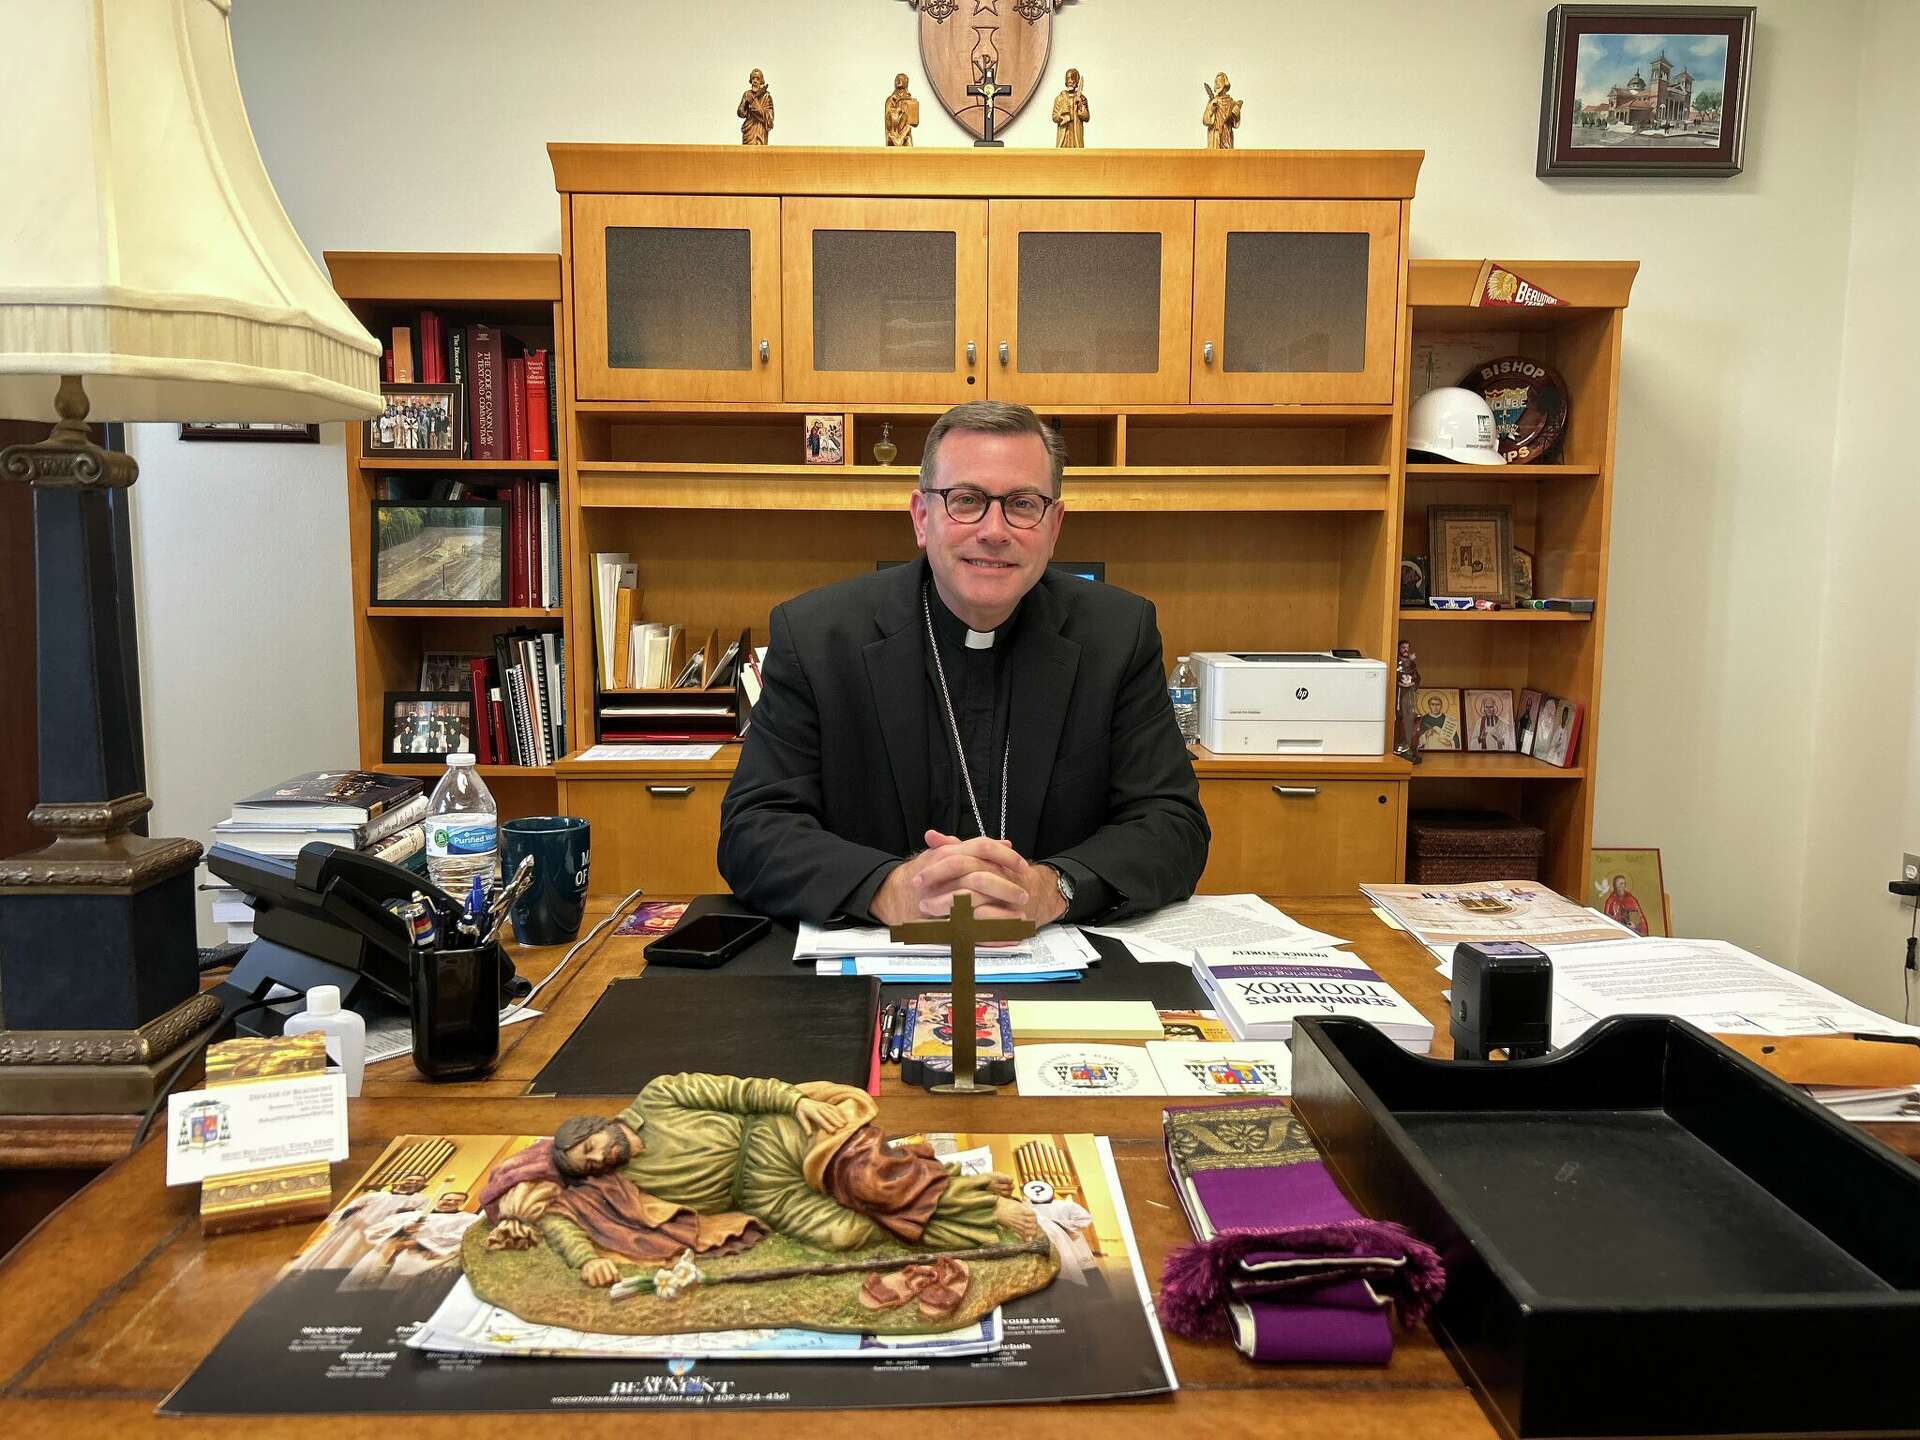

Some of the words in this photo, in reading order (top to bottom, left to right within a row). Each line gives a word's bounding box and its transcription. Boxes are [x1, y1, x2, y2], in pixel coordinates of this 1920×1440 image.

[1515, 281, 1558, 305] BEAUMONT
[1481, 360, 1546, 381] BISHOP
[484, 368, 492, 390] CODE
[478, 378, 486, 396] AND
[484, 390, 492, 401] OF
[479, 396, 487, 446] COMMENTARY
[485, 401, 493, 430] CANON
[1296, 687, 1309, 700] hp
[454, 836, 484, 844] Purified
[1282, 950, 1328, 958] PATRICK
[1274, 970, 1342, 978] Preparing
[1236, 982, 1388, 998] TOOLBOX
[1245, 996, 1398, 1008] SEMINARIAN'S
[1320, 1005, 1335, 1014] A
